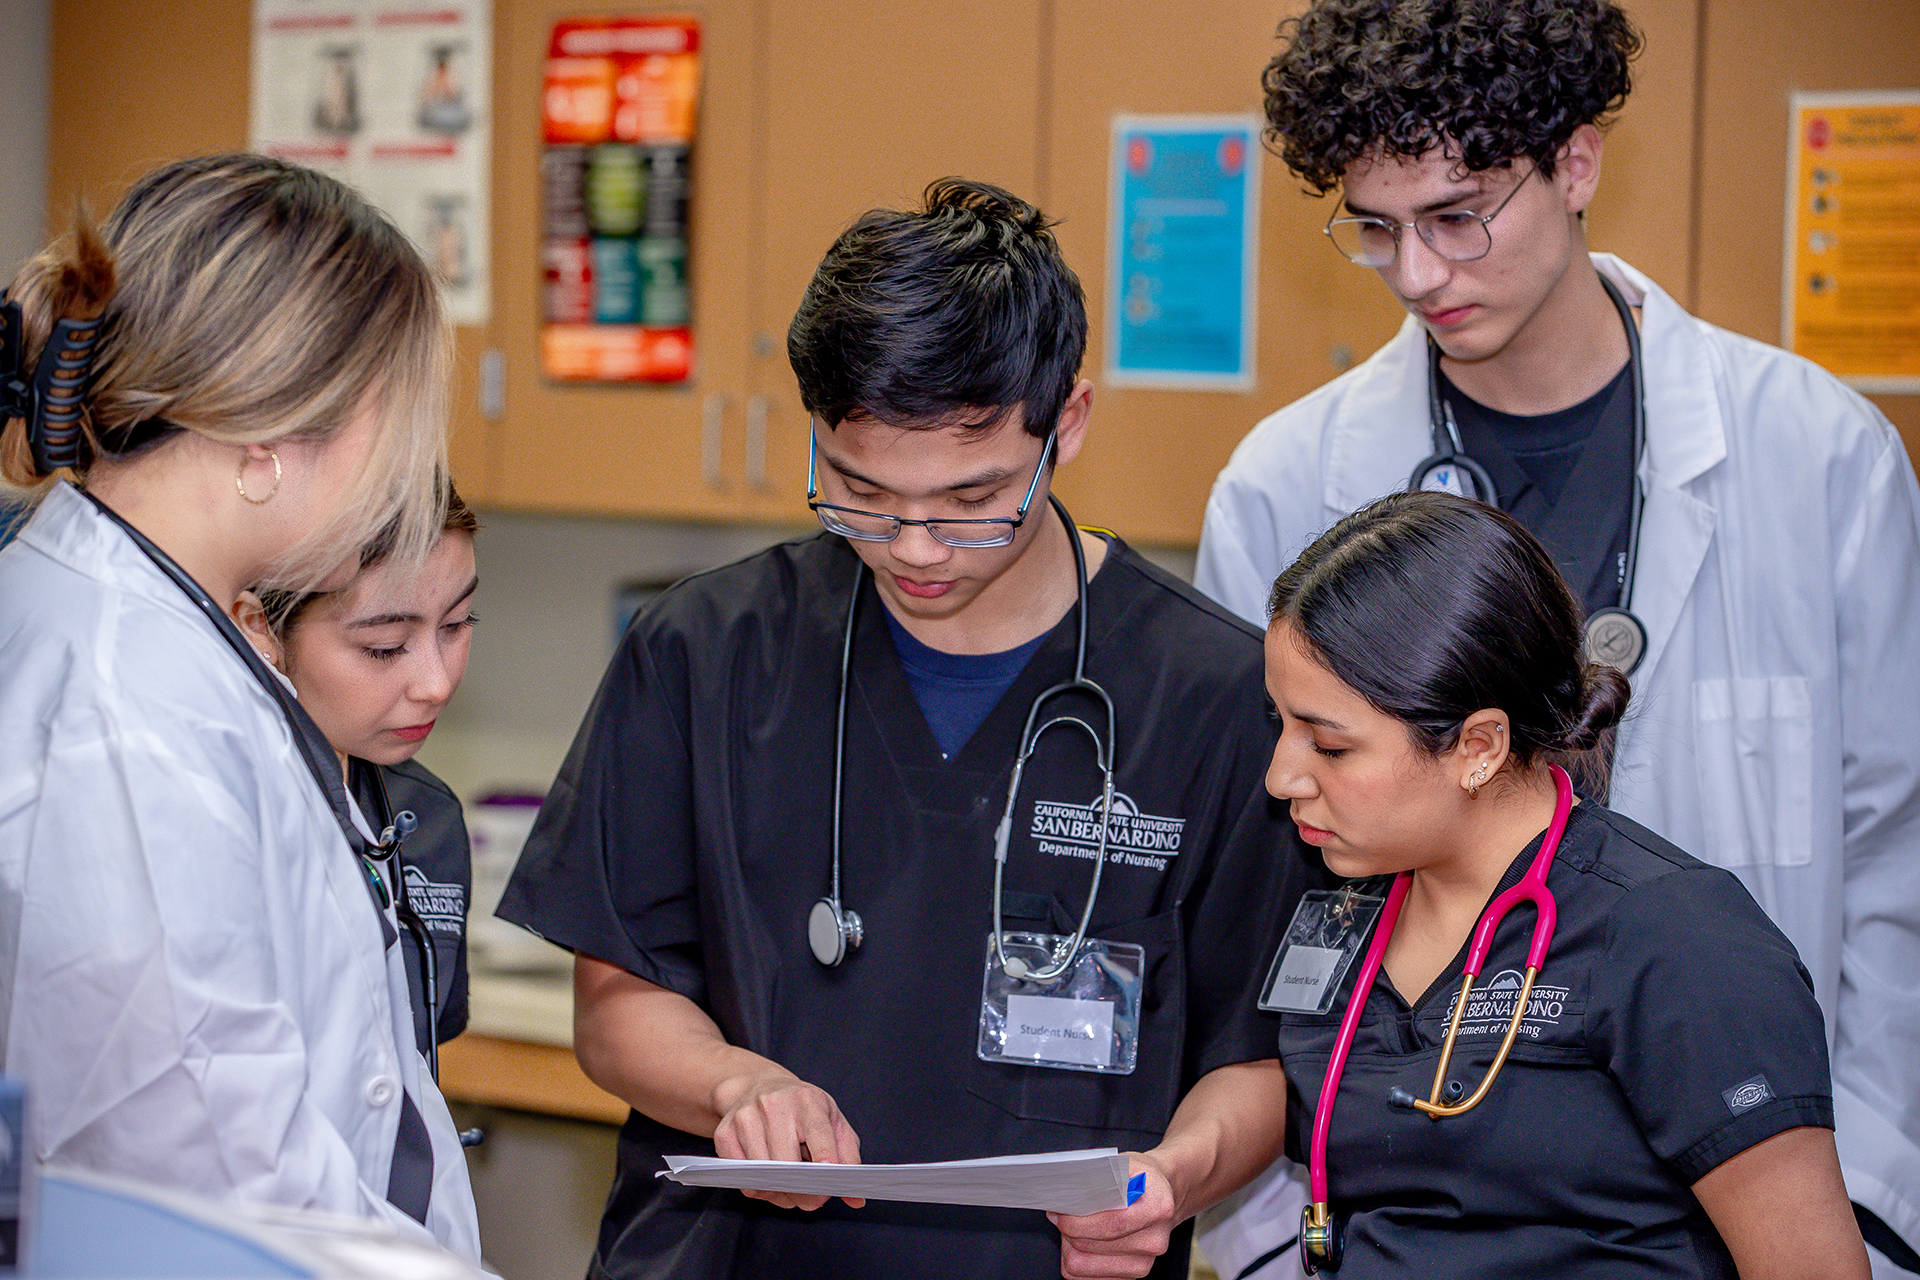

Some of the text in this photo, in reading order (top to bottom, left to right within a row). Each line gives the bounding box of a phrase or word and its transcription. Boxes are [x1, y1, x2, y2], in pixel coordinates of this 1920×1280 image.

[1034, 805, 1095, 822] CALIFORNIA
[1131, 818, 1184, 834] UNIVERSITY
[1111, 852, 1125, 864] of
[1125, 853, 1168, 871] Nursing
[1490, 991, 1514, 1000] STATE
[1514, 989, 1569, 1002] UVERSITY
[1020, 1024, 1061, 1038] Student
[1490, 1022, 1501, 1034] of
